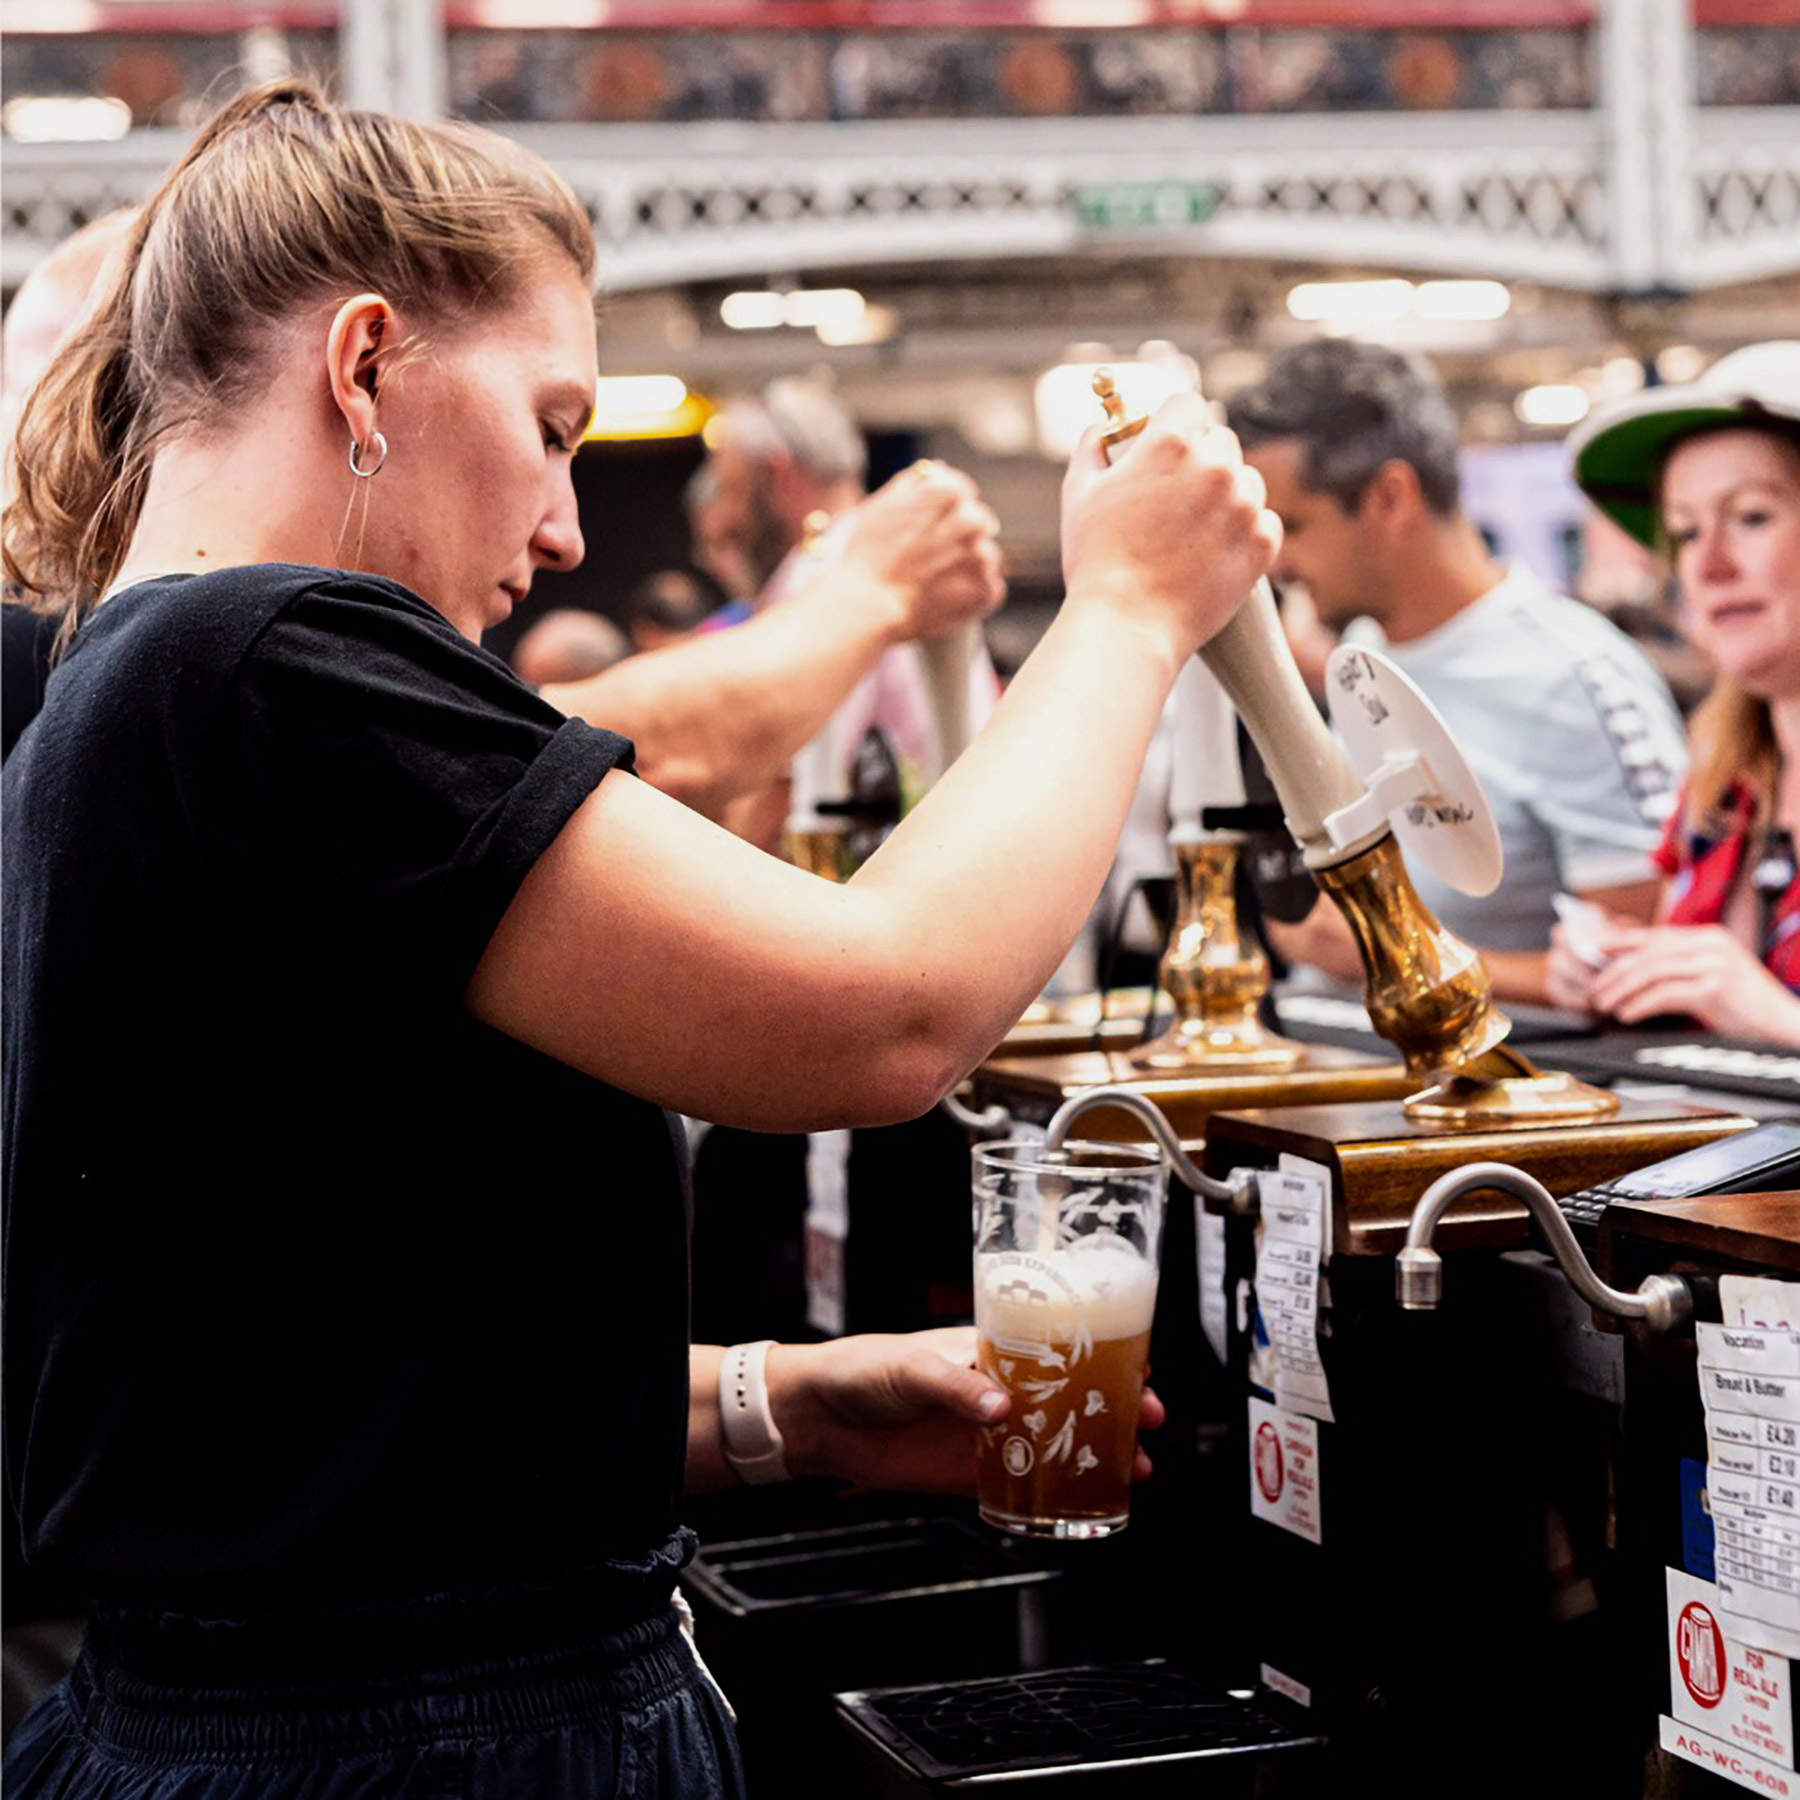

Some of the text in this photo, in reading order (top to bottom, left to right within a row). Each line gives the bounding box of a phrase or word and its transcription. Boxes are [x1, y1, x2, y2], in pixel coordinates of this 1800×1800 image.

[1744, 1378, 1753, 1394] &
[1753, 1379, 1786, 1398] Butter
[1767, 1423, 1796, 1446] £4.20
[1769, 1455, 1796, 1478] £2.10
[1767, 1484, 1794, 1508] £1.40
[1745, 1650, 1765, 1671] FOR
[1733, 1666, 1779, 1700] REAL ALE
[1677, 1735, 1788, 1796] AG-WC-608
